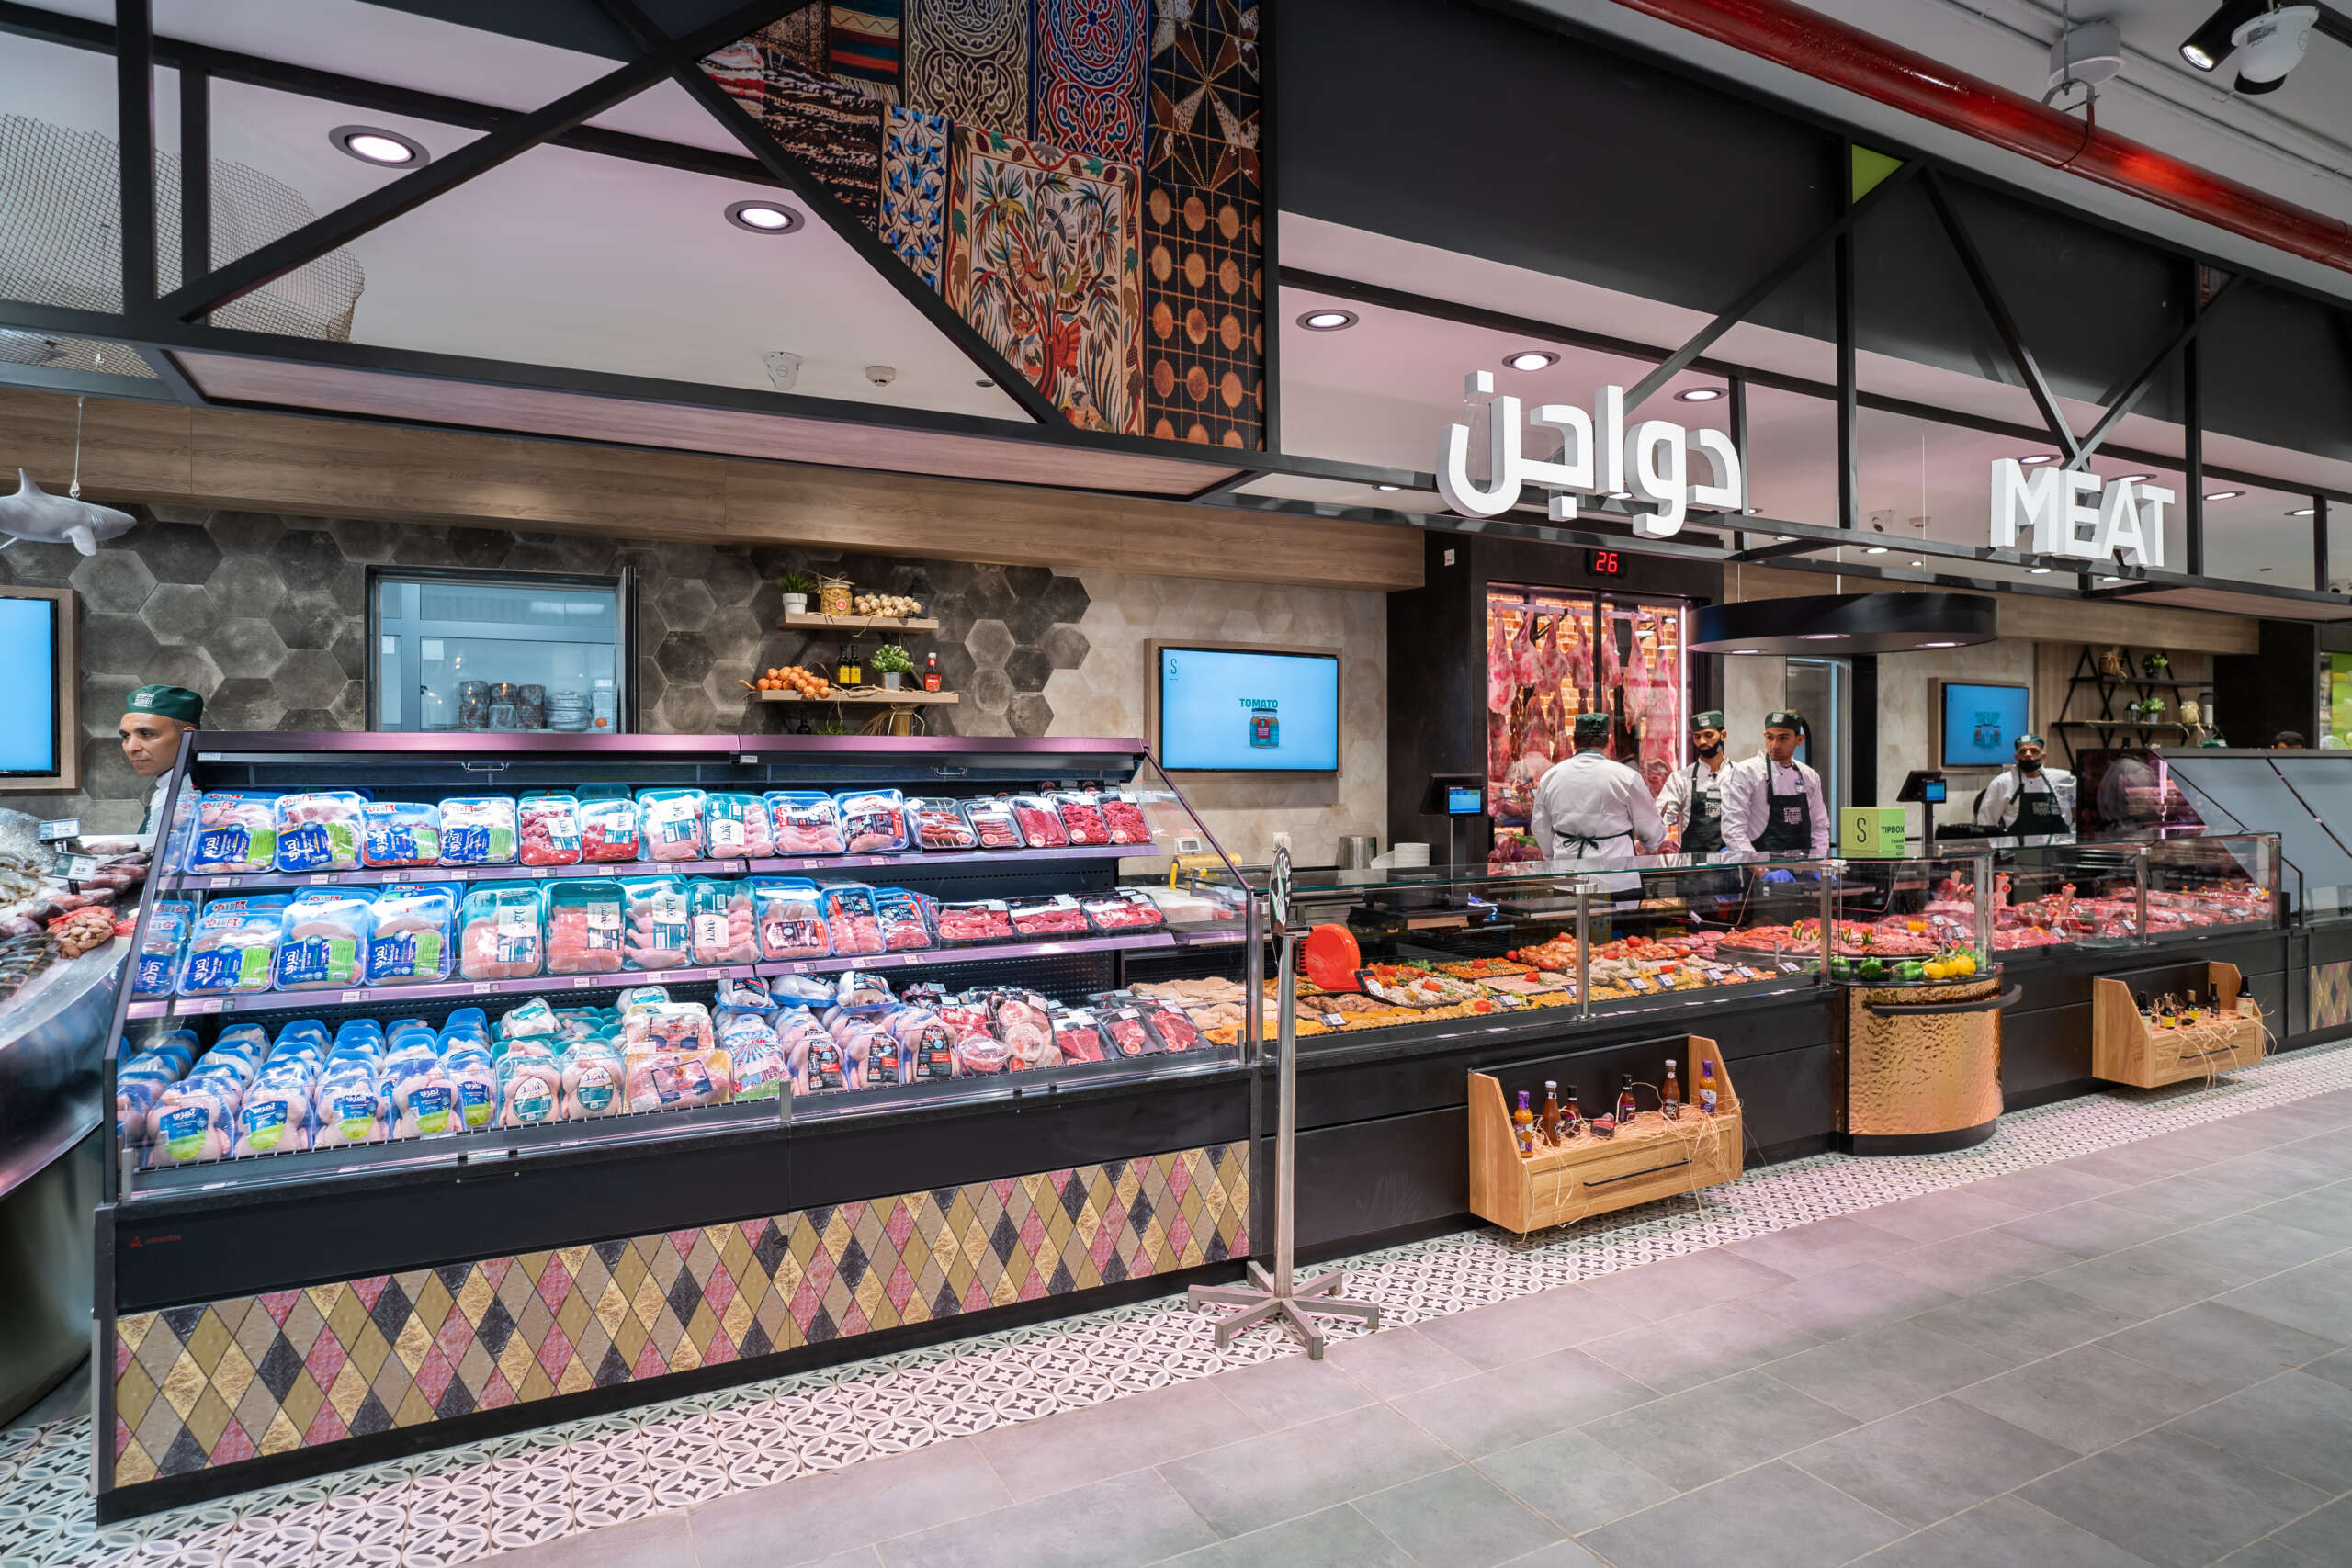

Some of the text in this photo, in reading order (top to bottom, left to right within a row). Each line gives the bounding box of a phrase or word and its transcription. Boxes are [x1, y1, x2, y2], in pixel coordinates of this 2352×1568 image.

[1437, 370, 1743, 538] دواجن
[1991, 457, 2175, 568] MEAT
[1596, 551, 1618, 572] 26
[1170, 658, 1177, 674] S
[1239, 698, 1279, 708] TOMATO
[1857, 817, 1867, 843] S
